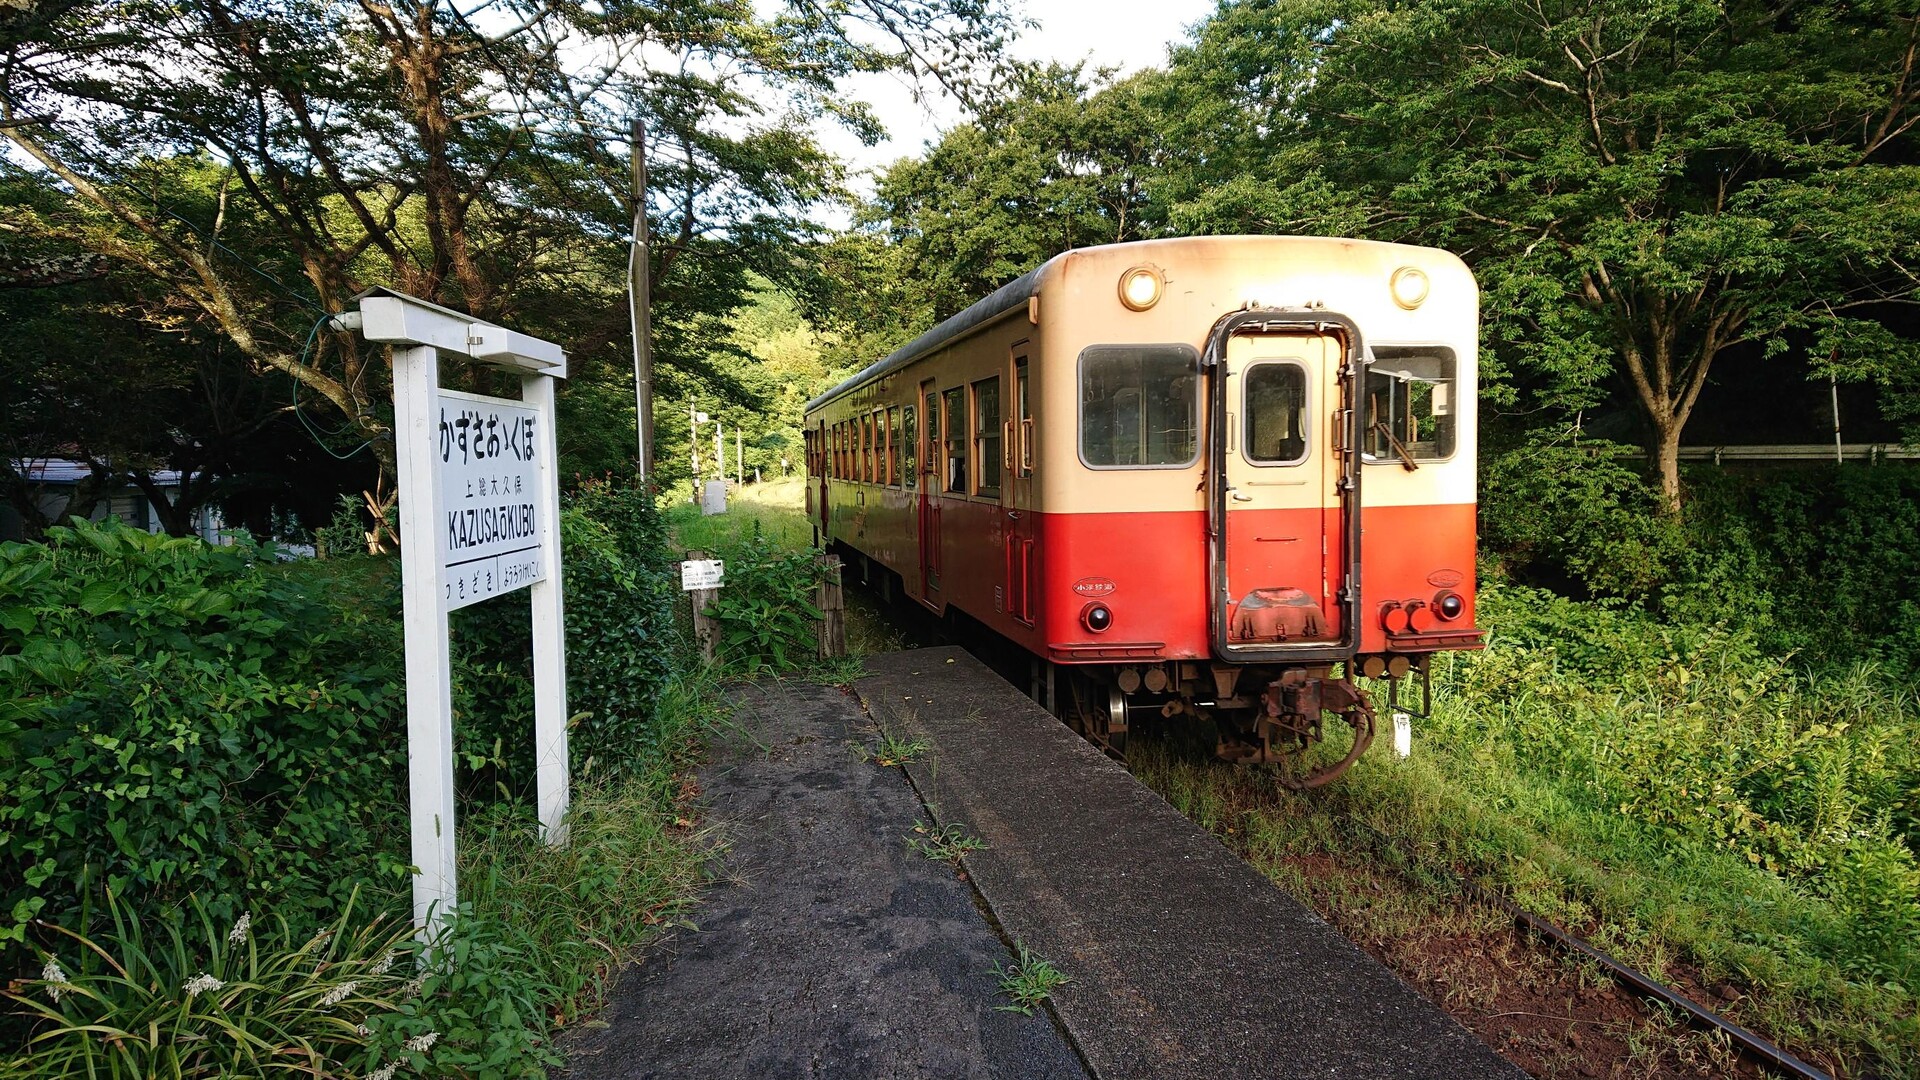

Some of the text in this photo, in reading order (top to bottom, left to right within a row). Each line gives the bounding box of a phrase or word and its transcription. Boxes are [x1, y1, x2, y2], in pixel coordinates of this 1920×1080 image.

[466, 474, 522, 498] 上総大久保
[446, 570, 492, 600] つきざき
